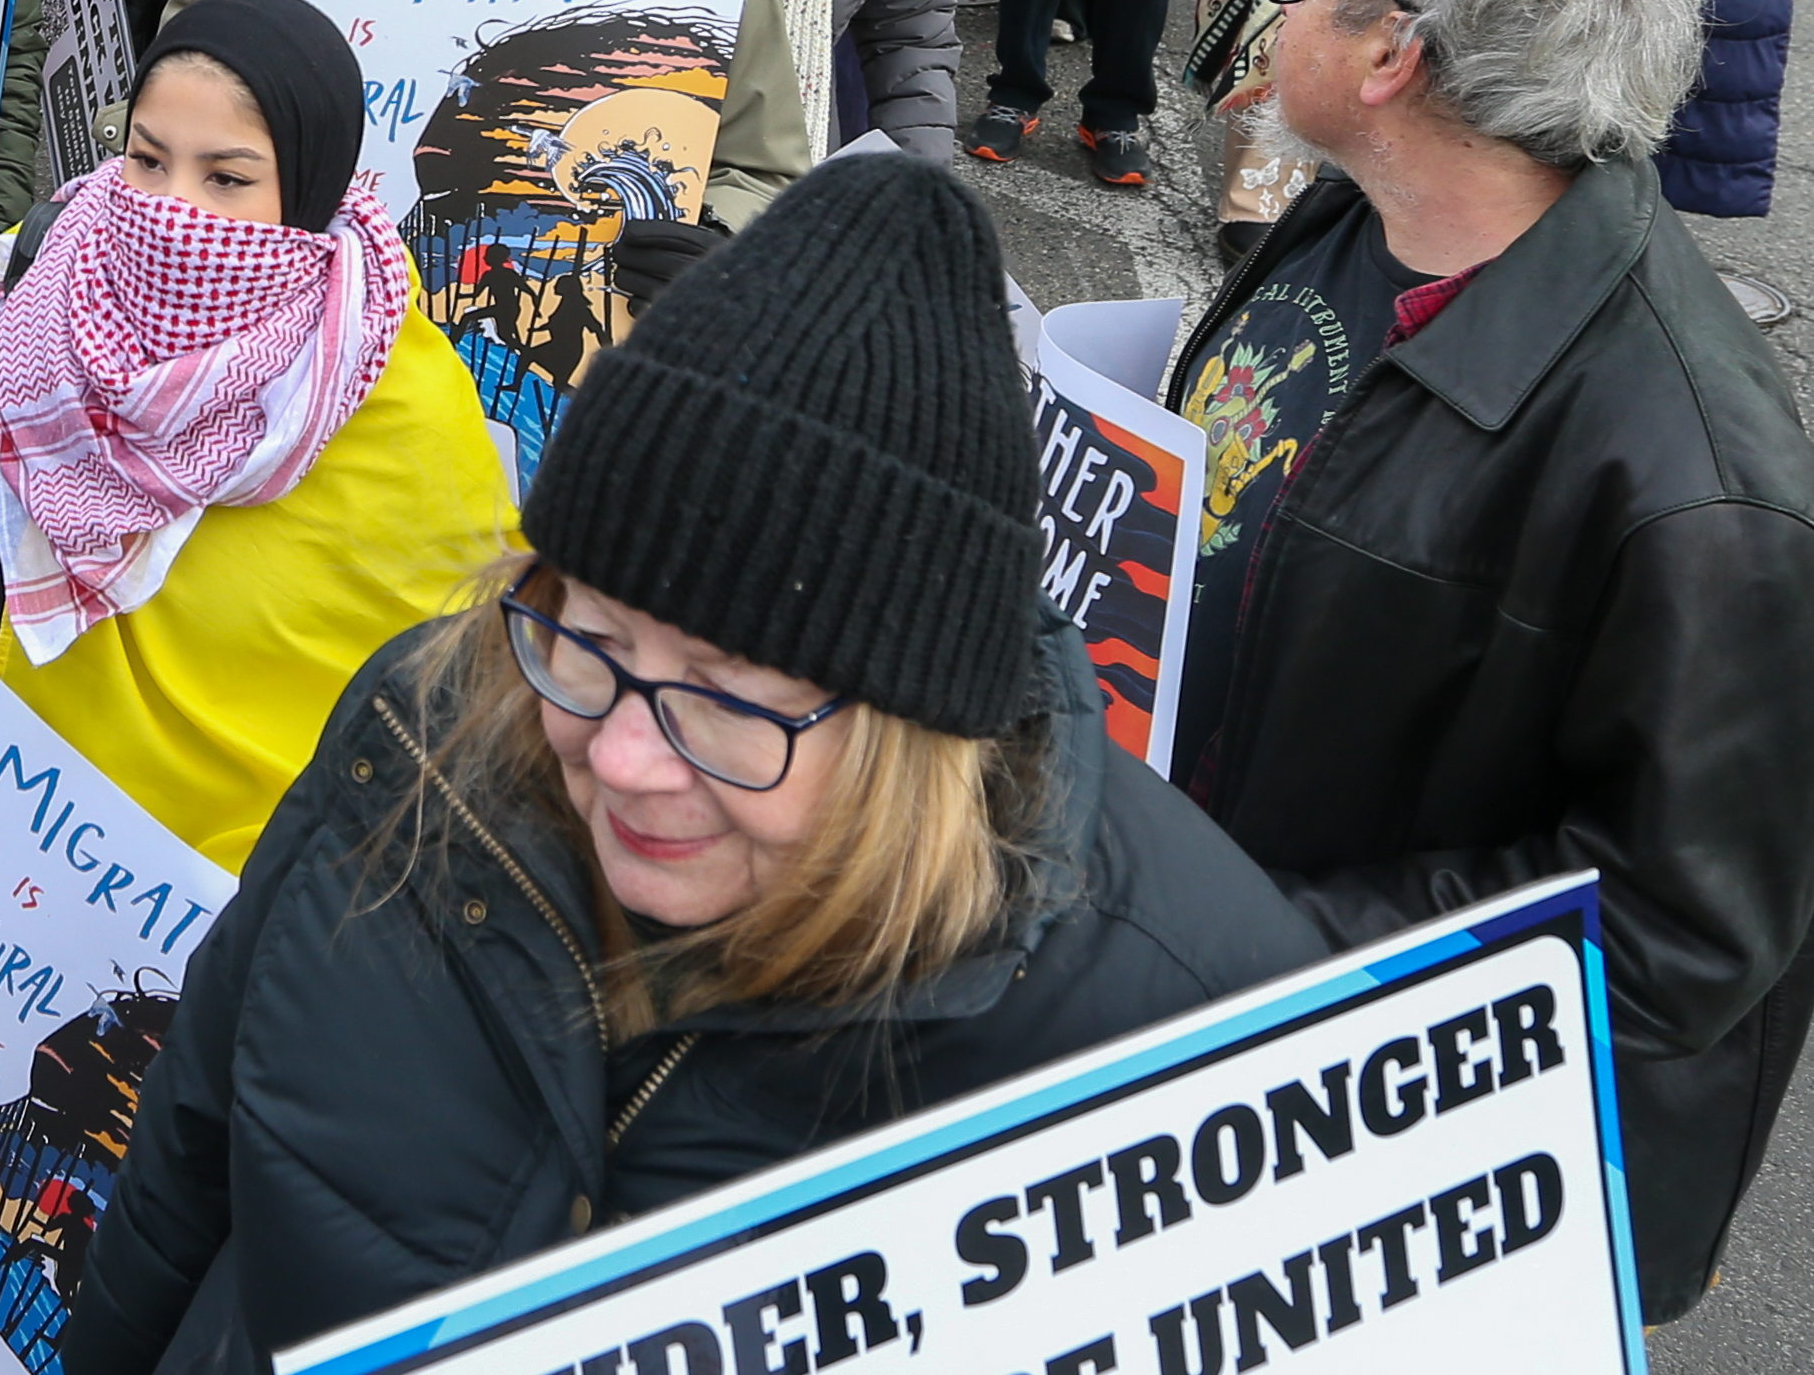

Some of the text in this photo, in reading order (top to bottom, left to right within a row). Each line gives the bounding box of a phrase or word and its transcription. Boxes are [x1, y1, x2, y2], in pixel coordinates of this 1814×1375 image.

[349, 17, 376, 47] IS
[363, 78, 425, 143] RAL
[354, 168, 387, 192] ME
[1250, 283, 1291, 303] CAL
[1031, 377, 1136, 557] THER
[1036, 511, 1112, 630] OME
[12, 875, 45, 910] IS
[531, 982, 1566, 1375] DER, STRONGER
[1148, 1151, 1566, 1375] UNITED
